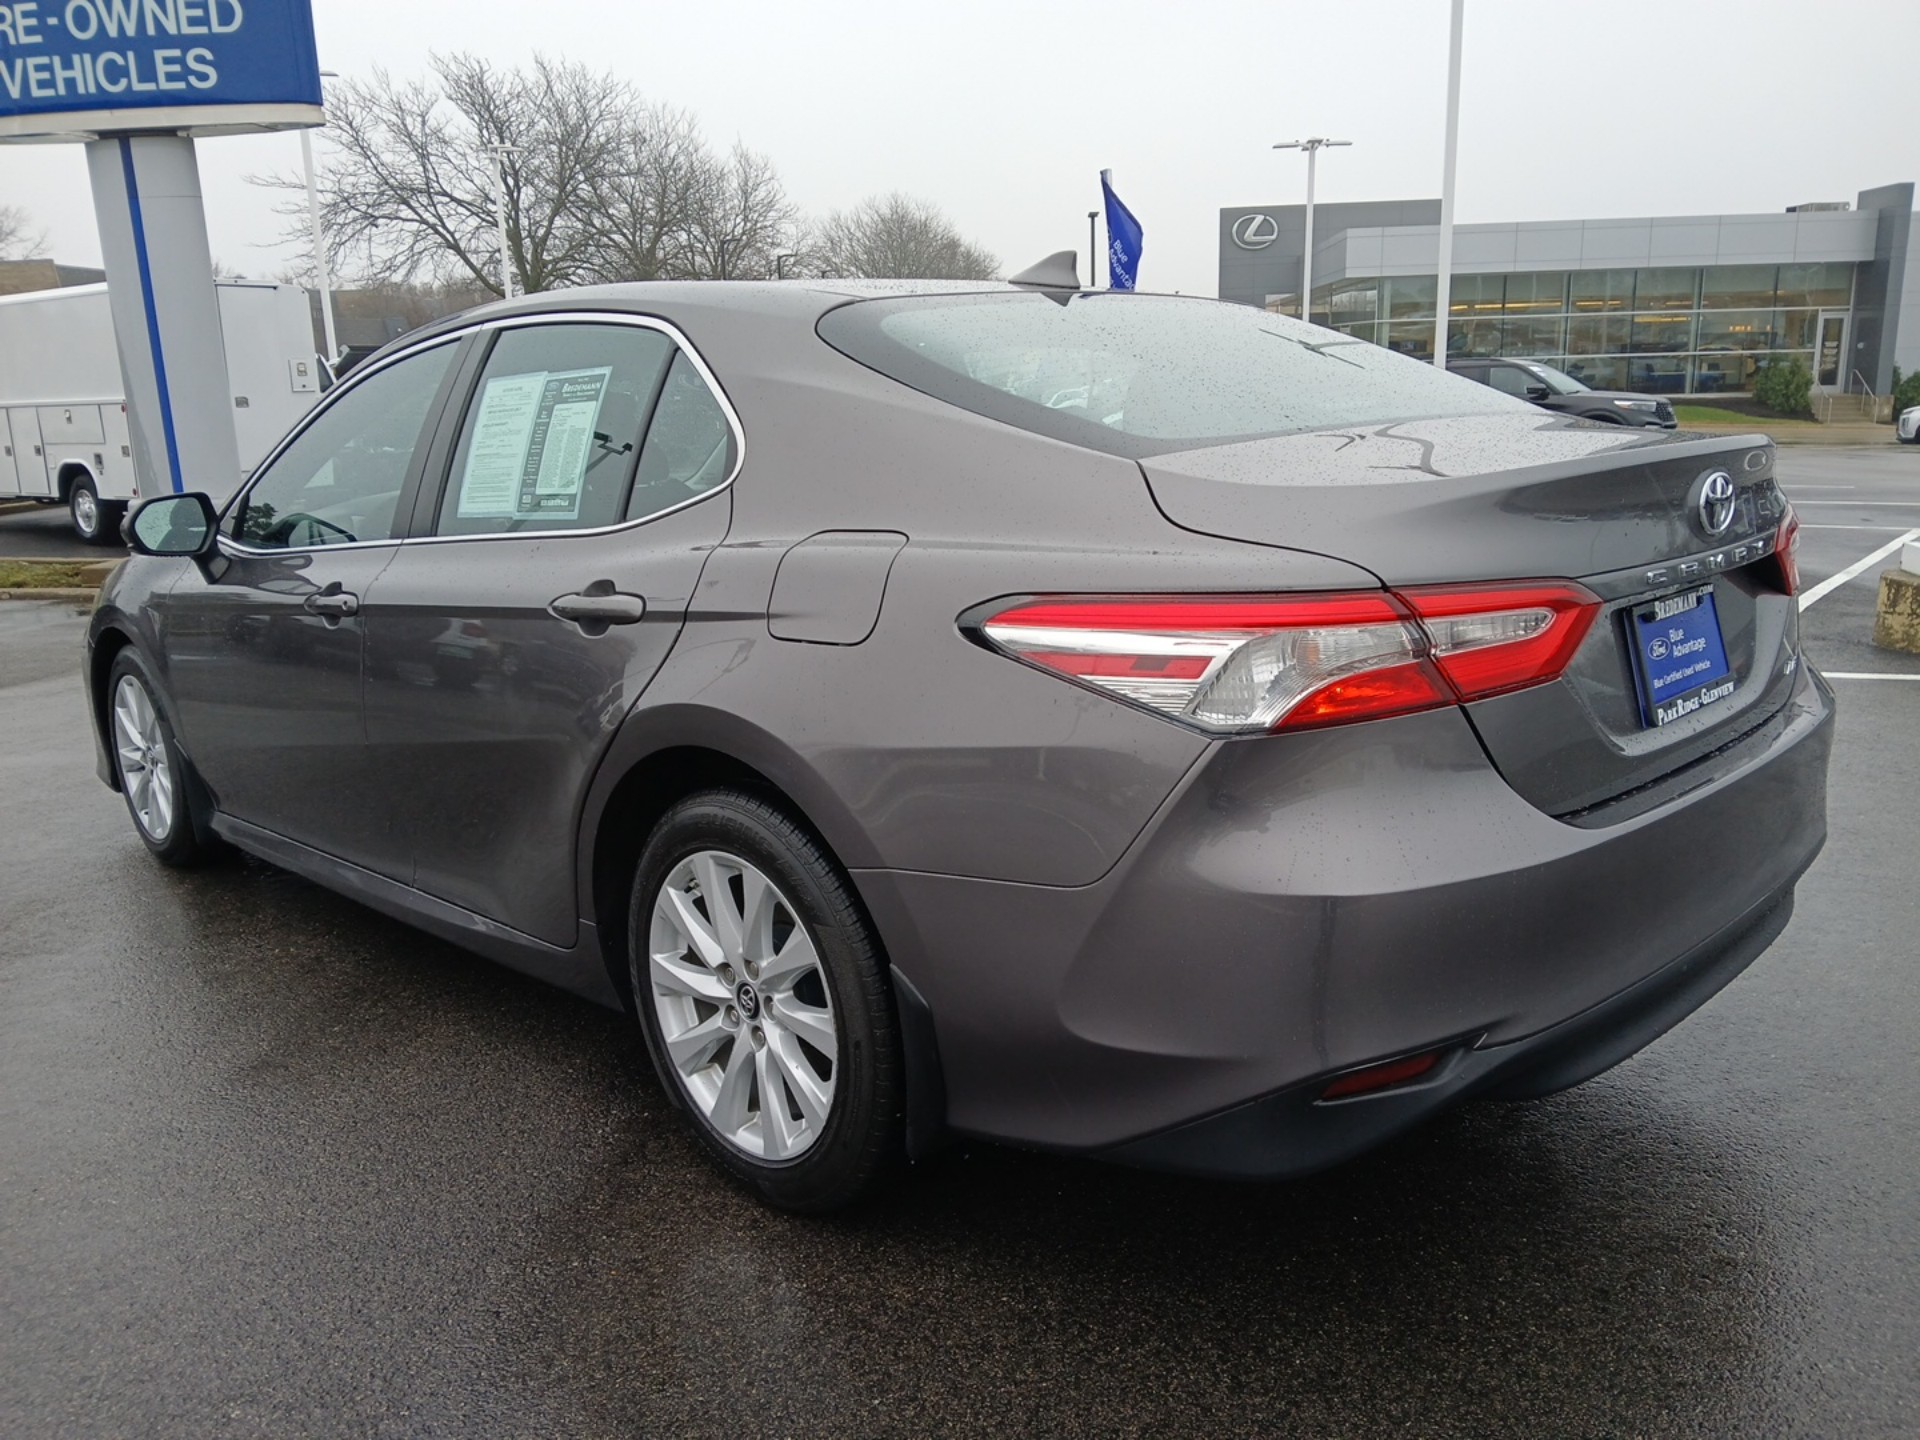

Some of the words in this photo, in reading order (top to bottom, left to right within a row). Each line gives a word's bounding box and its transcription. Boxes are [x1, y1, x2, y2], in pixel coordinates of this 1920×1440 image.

[0, 48, 218, 99] VEHICLES
[1113, 239, 1128, 263] Blue
[1668, 627, 1684, 642] Blue
[1673, 637, 1706, 658] Advantage
